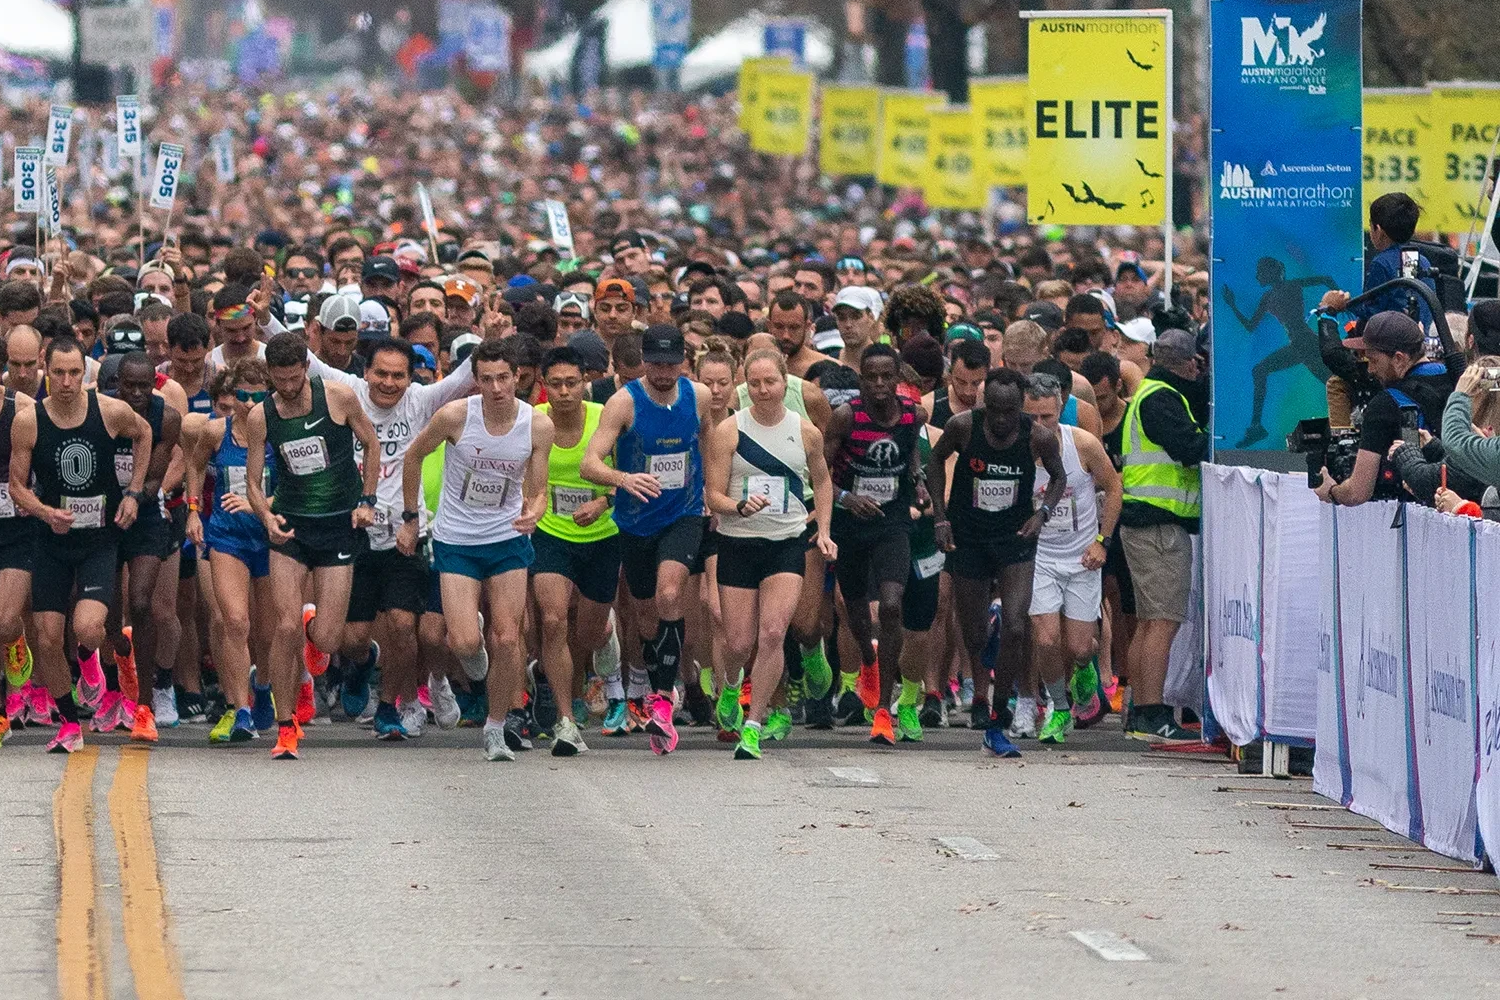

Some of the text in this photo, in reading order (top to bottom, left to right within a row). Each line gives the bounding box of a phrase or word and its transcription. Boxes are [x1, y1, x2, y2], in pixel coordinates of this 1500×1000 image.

[1241, 76, 1327, 84] MANZANO MILE
[1036, 100, 1159, 139] ELITE
[123, 109, 138, 144] 3:15
[51, 119, 68, 154] 3:15
[1366, 127, 1417, 147] PACE
[16, 153, 38, 161] PACER
[1281, 164, 1352, 173] Ascension Seton
[1363, 154, 1421, 182] 3:35
[1444, 151, 1489, 182] 3:3
[21, 161, 35, 201] 3:05
[159, 158, 178, 198] 3:05
[1241, 200, 1264, 208] HALF
[1267, 200, 1326, 208] MARATHON
[1341, 199, 1352, 208] 5K
[288, 444, 320, 459] 18602
[471, 460, 516, 471] TEXAS
[653, 460, 684, 473] 10030
[987, 464, 1024, 475] ROLL
[471, 481, 503, 494] 10033
[761, 484, 769, 496] 3
[981, 486, 1012, 496] 10039
